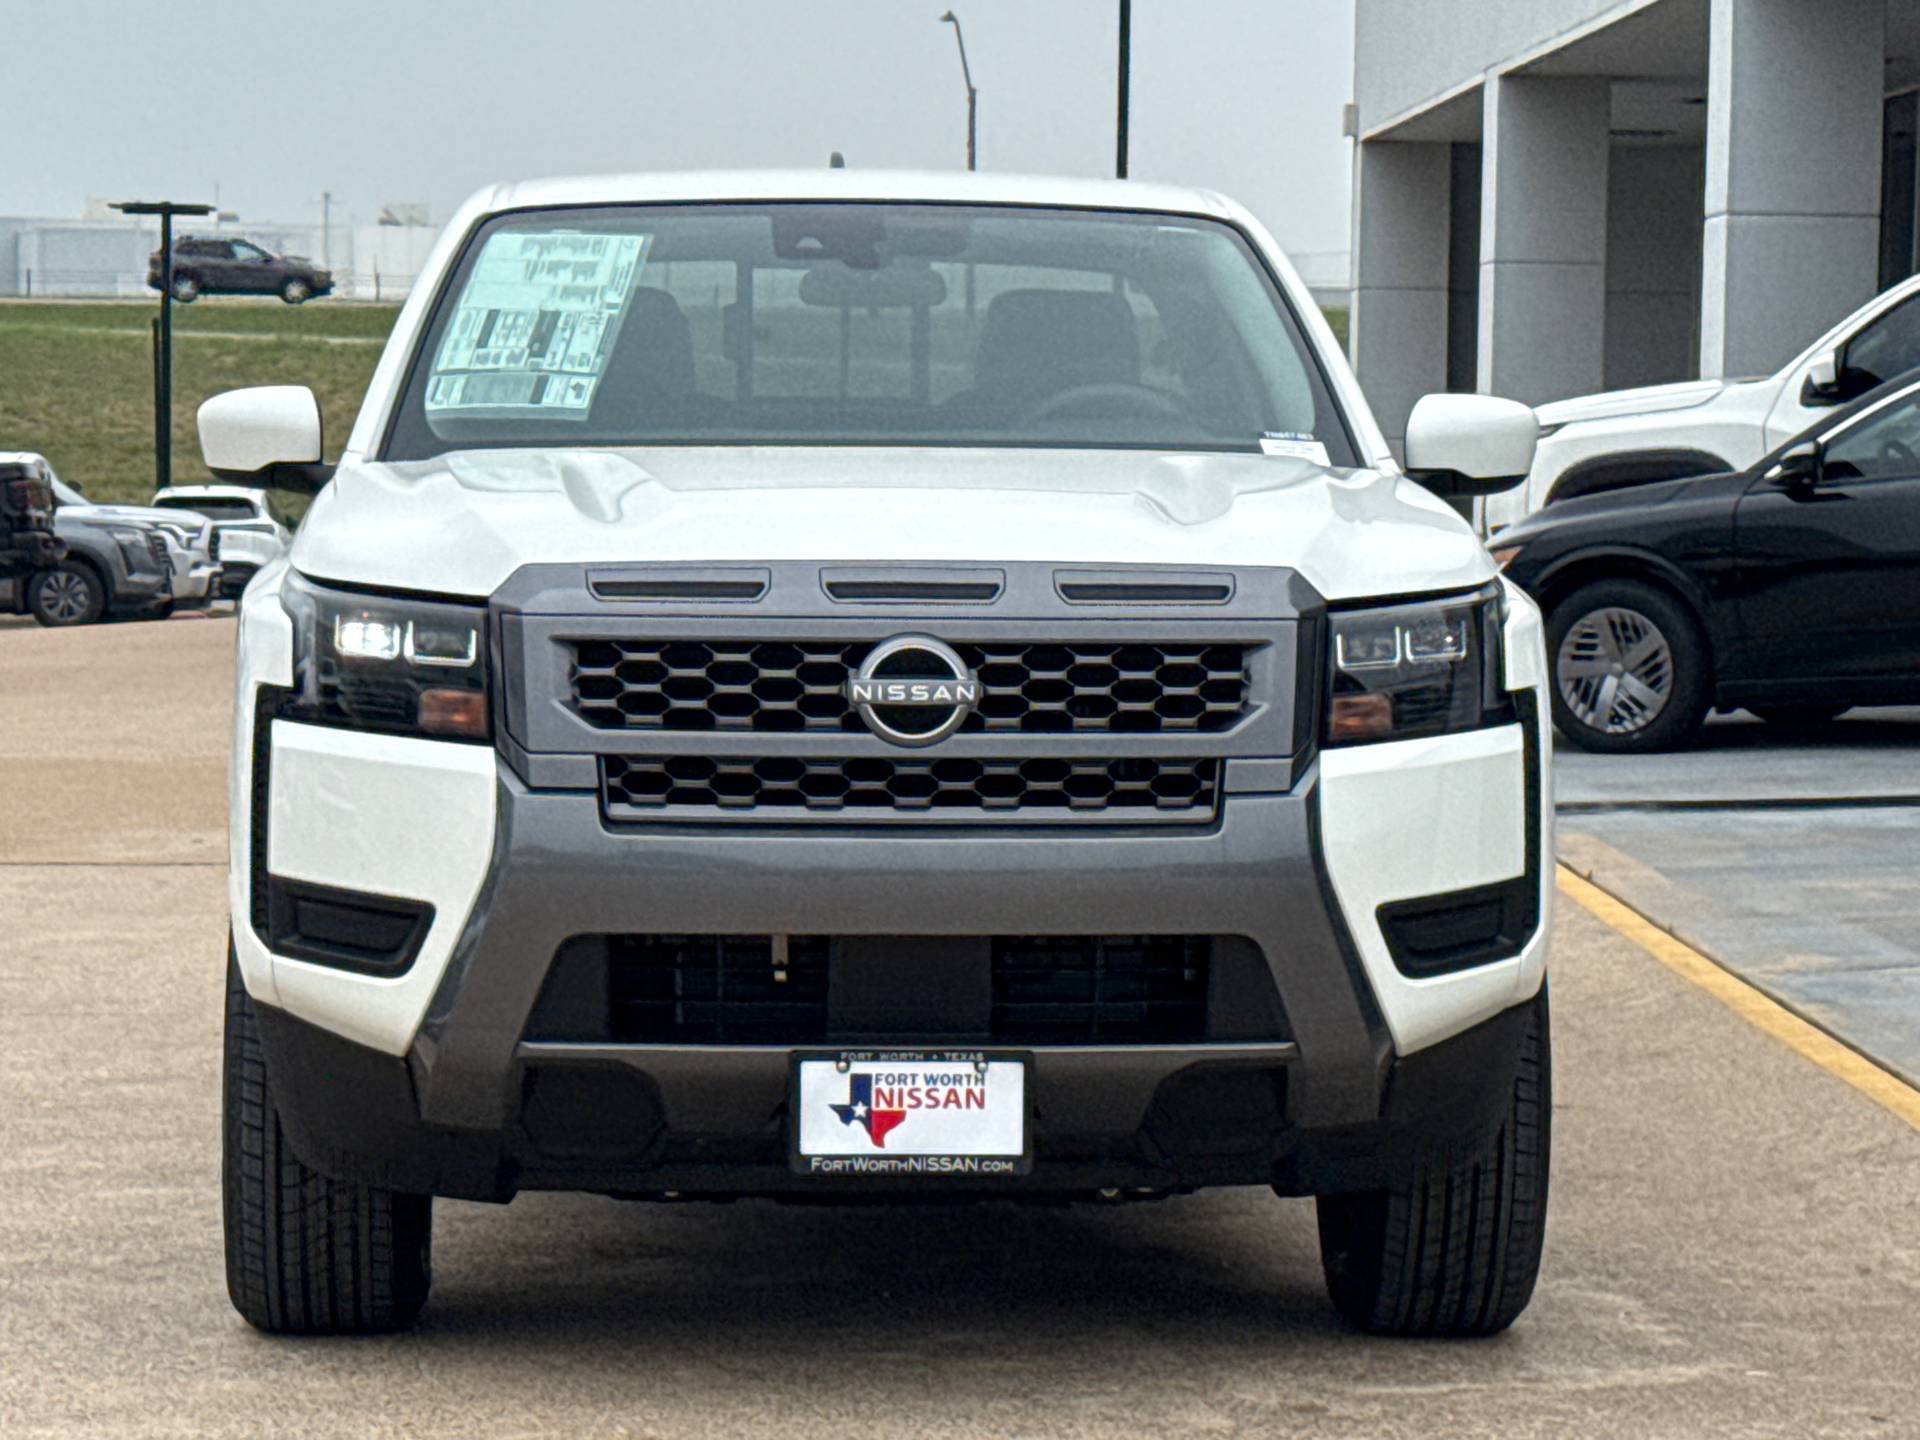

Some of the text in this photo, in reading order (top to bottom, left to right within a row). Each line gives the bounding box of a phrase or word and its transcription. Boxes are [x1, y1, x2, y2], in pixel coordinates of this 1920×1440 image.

[853, 684, 975, 701] NISSAN
[841, 1052, 984, 1061] FORT WORTH TEXAS
[874, 1073, 985, 1086] FORT WORTH
[874, 1087, 985, 1109] NISSAN
